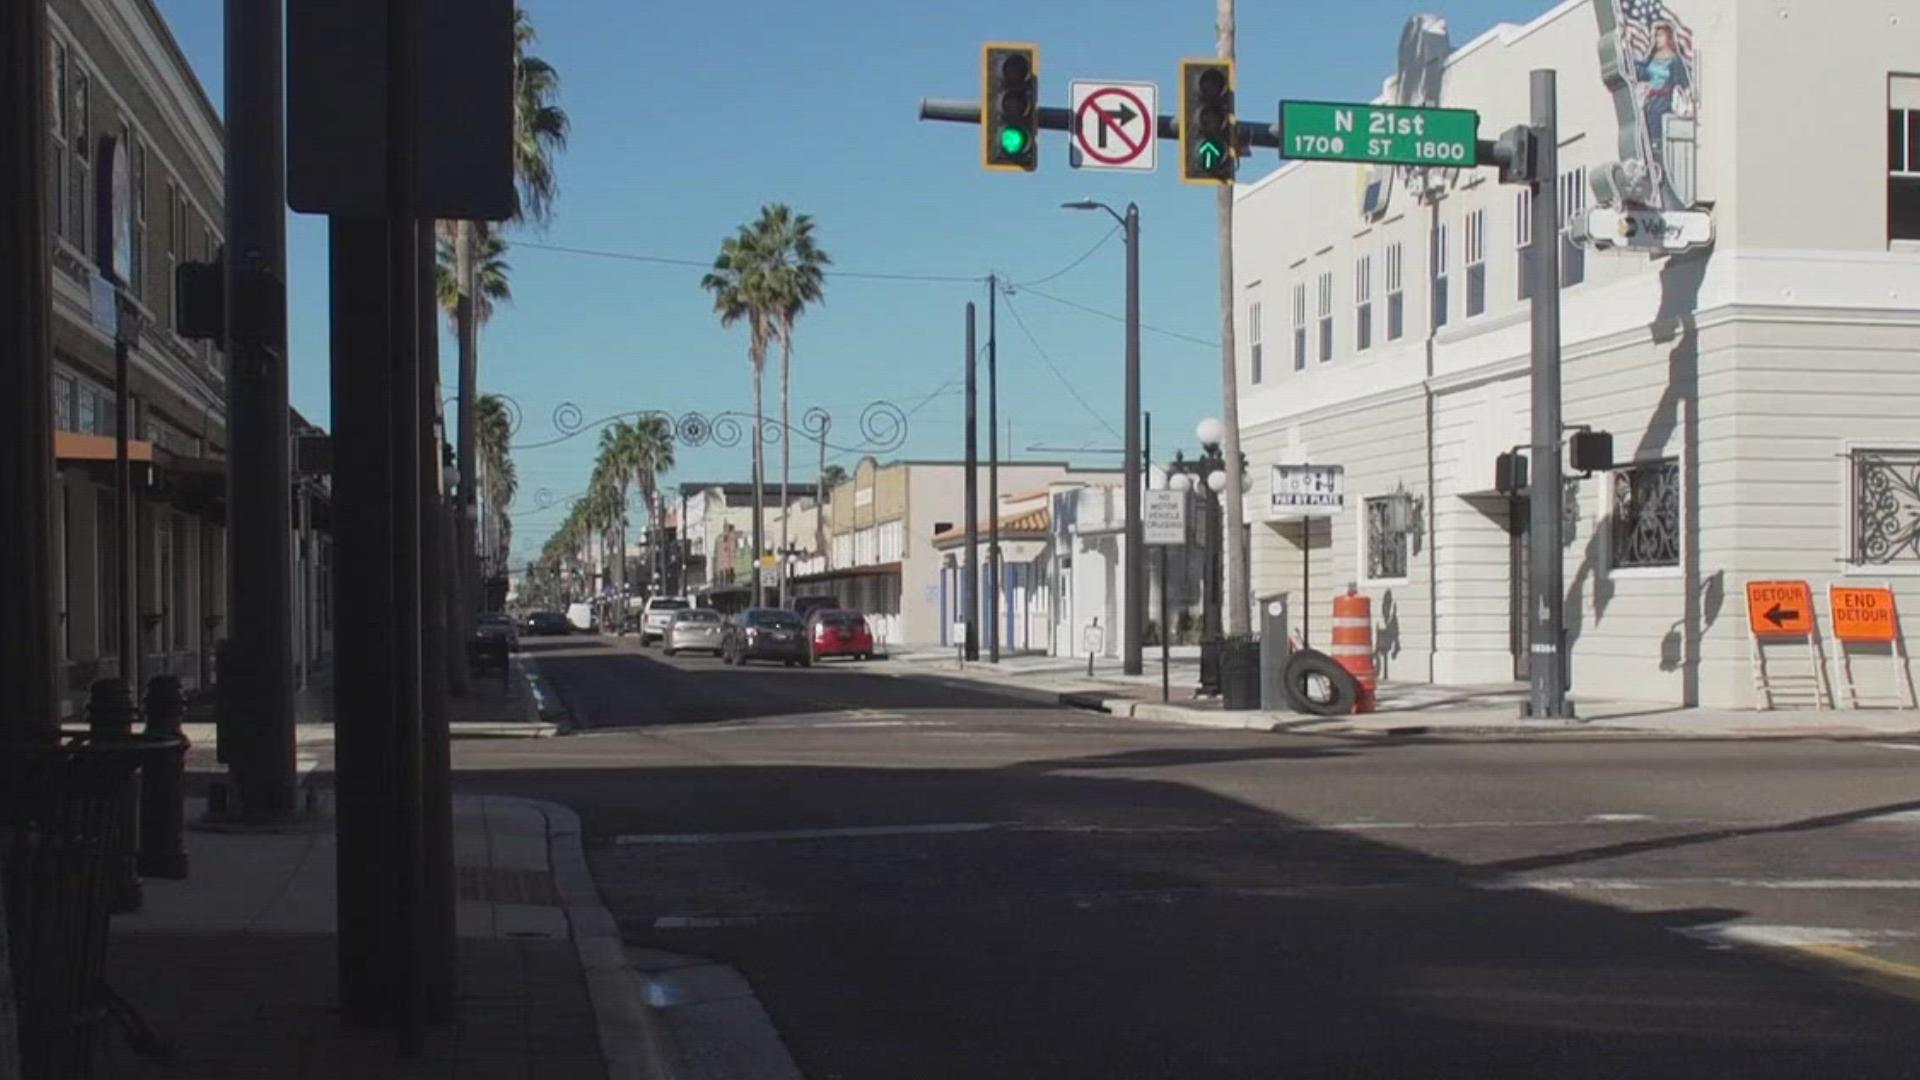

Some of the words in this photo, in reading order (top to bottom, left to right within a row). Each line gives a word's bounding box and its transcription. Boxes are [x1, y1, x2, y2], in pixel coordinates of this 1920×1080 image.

[1336, 110, 1353, 133] N
[1369, 112, 1424, 135] 21st
[1295, 135, 1344, 154] 1700
[1368, 139, 1392, 156] ST
[1416, 141, 1464, 159] 1800
[1312, 495, 1337, 505] PLATE
[1149, 512, 1179, 520] VEHICLE
[1753, 588, 1803, 601] DETOUR
[1845, 594, 1876, 608] END
[1838, 609, 1888, 621] DETOUR
